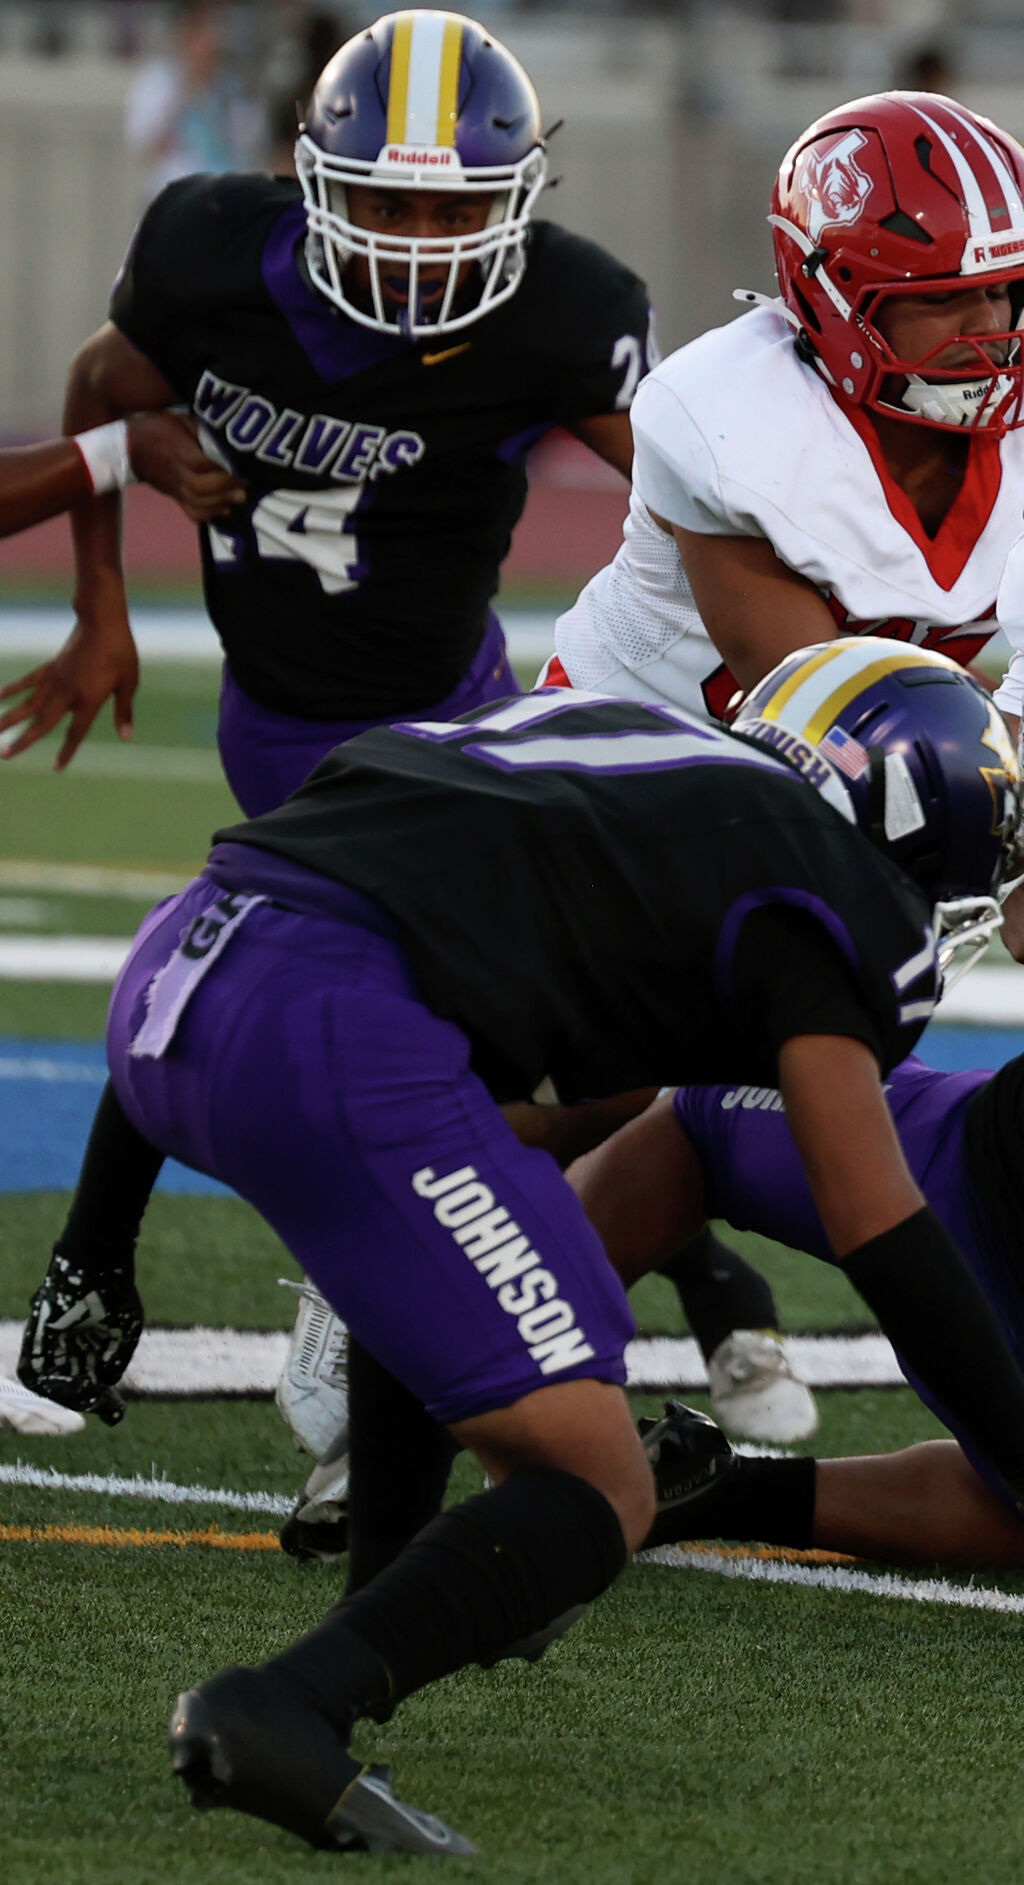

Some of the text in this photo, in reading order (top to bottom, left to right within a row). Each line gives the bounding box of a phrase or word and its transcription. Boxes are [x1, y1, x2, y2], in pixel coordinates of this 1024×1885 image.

[193, 369, 426, 483] WOLVES
[744, 721, 832, 789] INISH
[411, 1165, 596, 1376] JOHNSON
